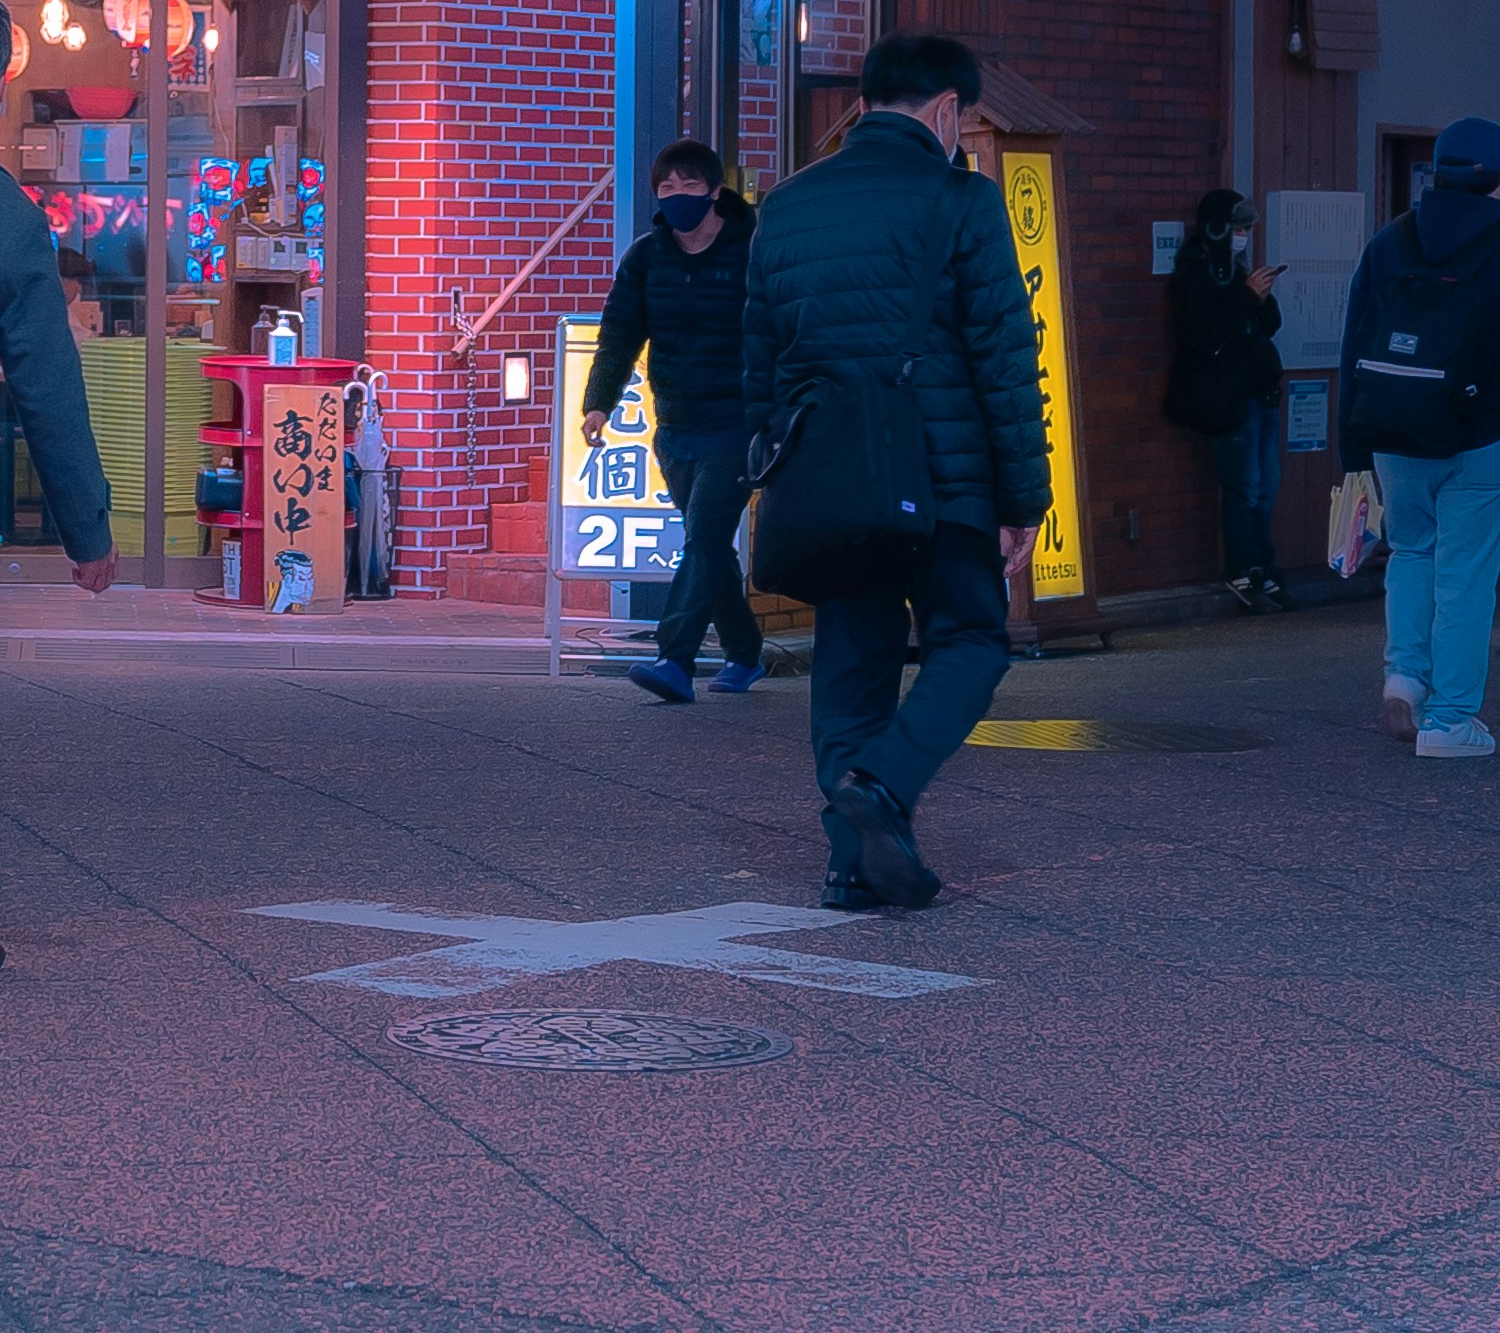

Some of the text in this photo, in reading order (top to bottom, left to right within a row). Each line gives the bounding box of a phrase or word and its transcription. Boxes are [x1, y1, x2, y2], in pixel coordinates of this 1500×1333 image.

[272, 409, 315, 547] 商い中
[314, 391, 338, 493] ただいま
[1034, 562, 1077, 582] Ittetsu
